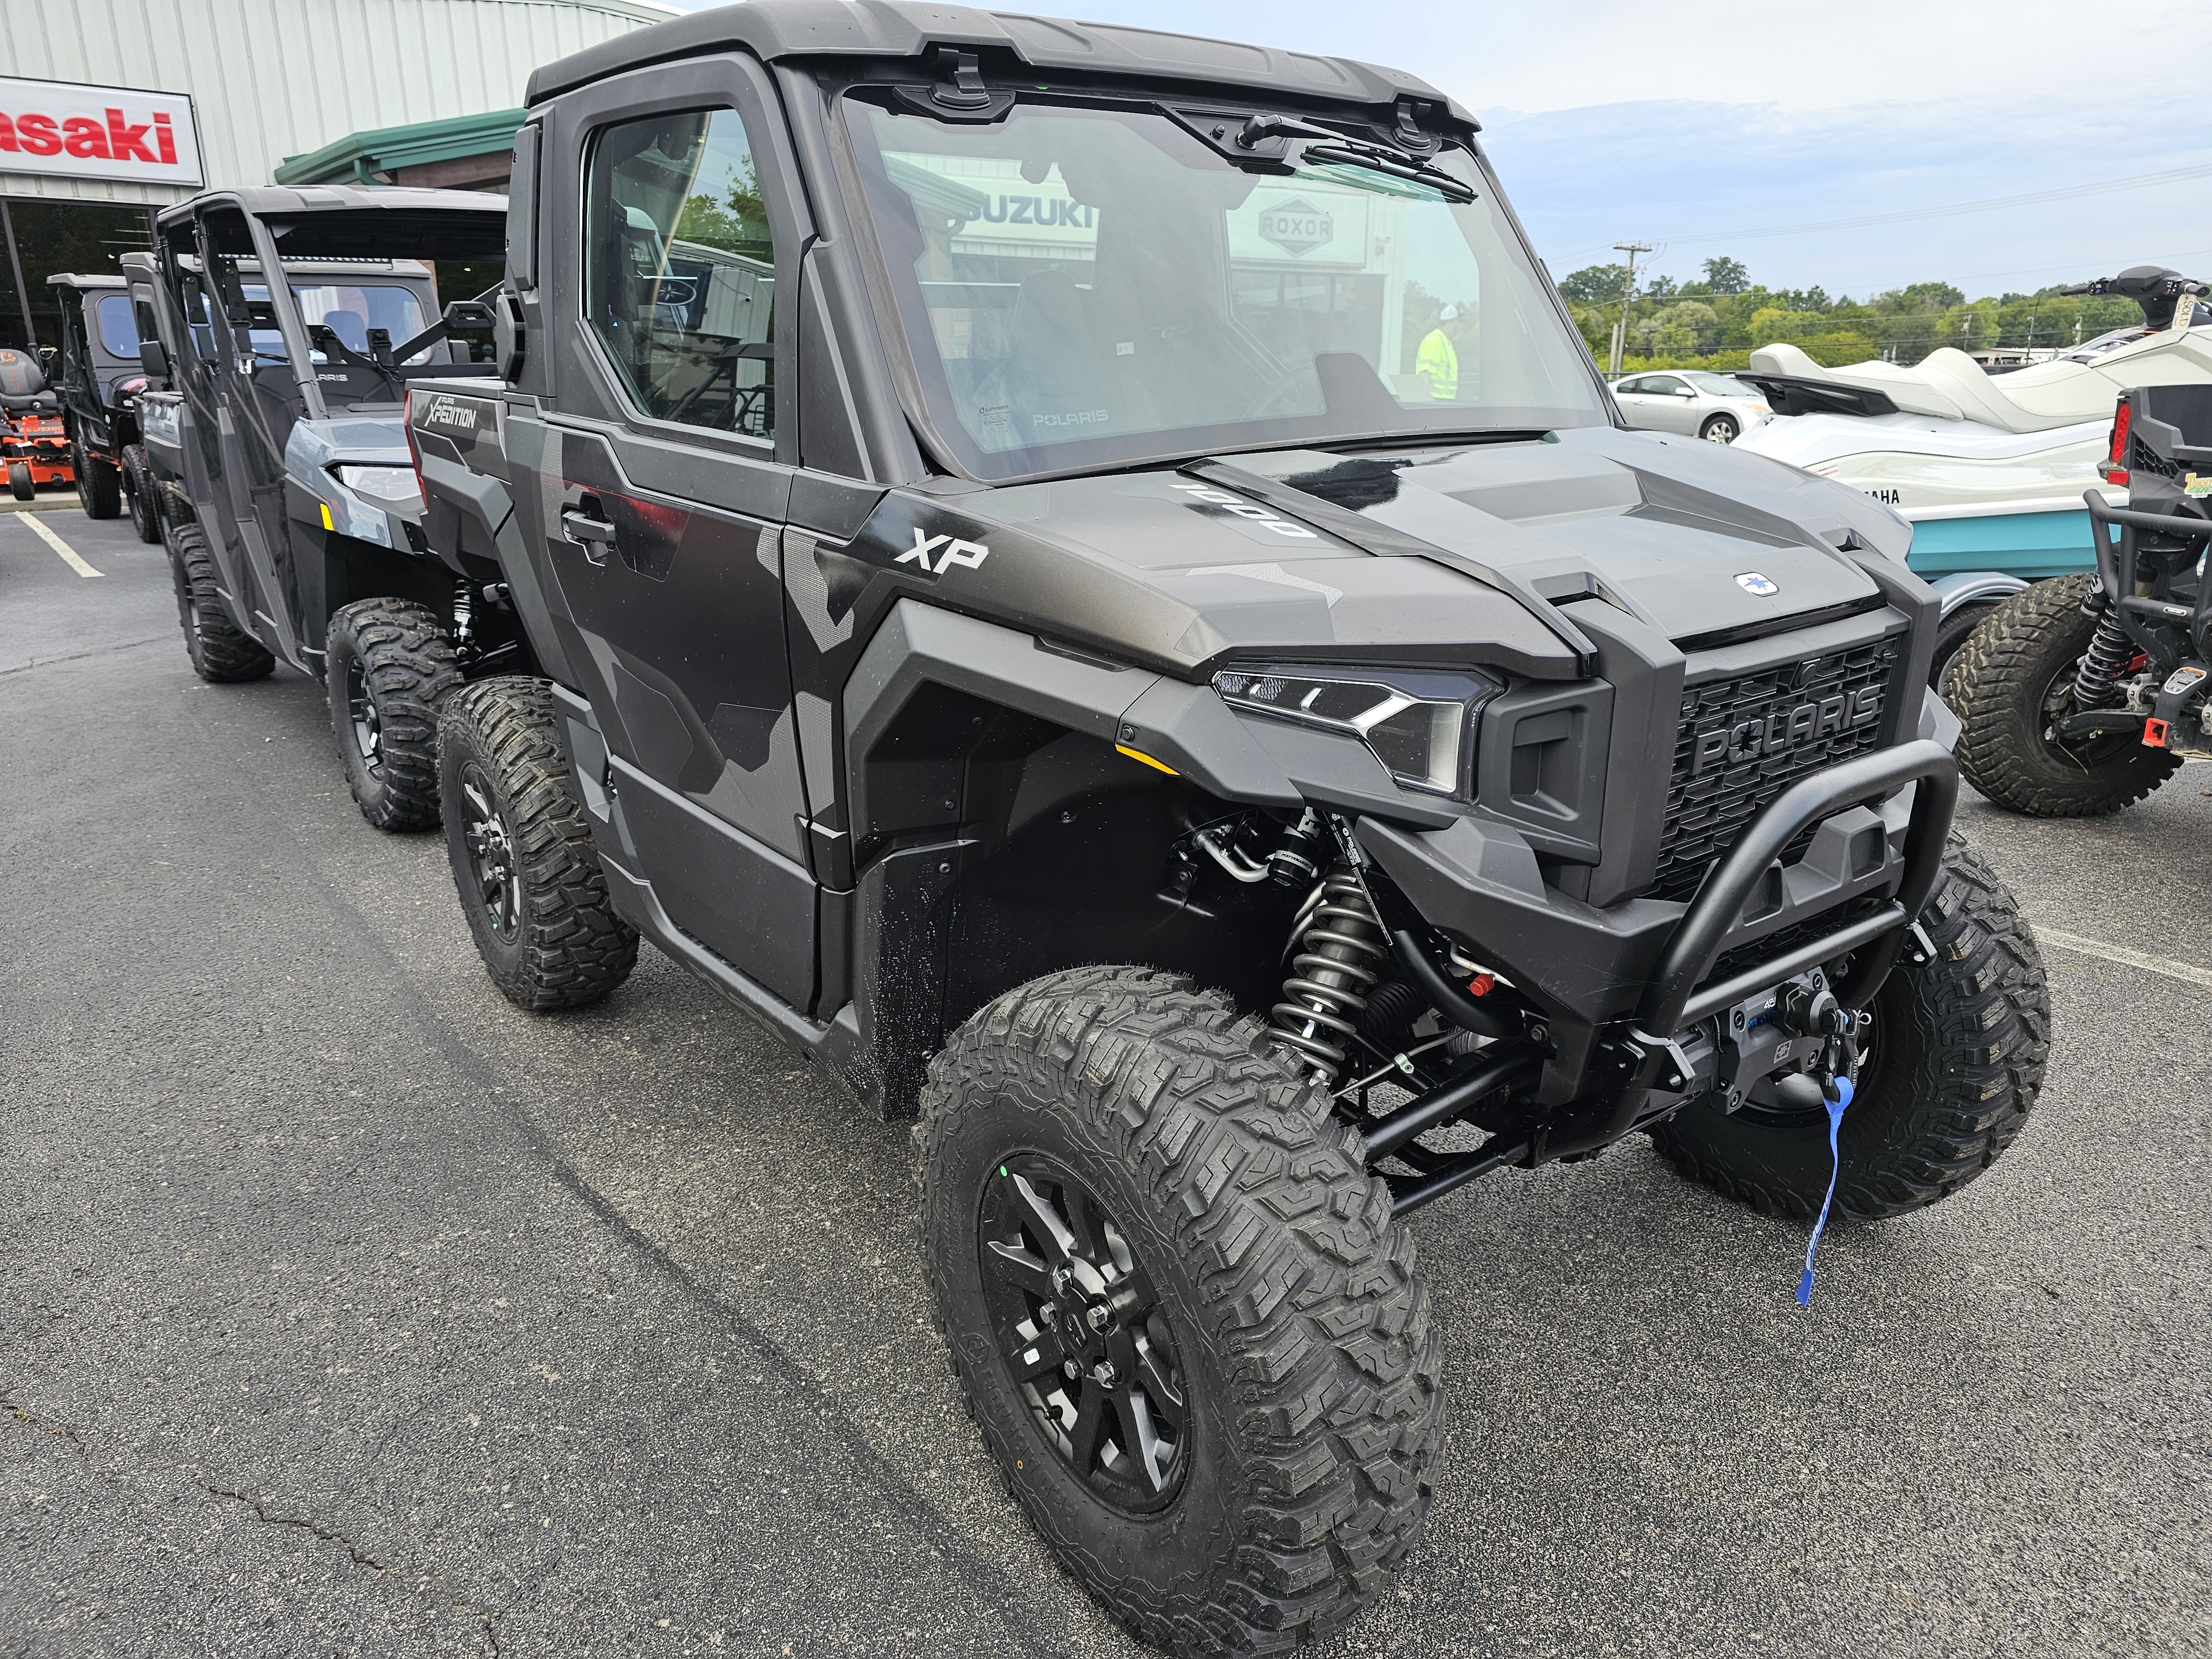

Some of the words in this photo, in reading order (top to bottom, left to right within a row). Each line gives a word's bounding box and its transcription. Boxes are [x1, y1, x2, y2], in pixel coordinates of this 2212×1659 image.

[1262, 216, 1330, 237] ROXOR
[2180, 301, 2194, 326] SOLD
[424, 396, 477, 429] XPEDITION
[1032, 409, 1109, 426] POLARIS
[1168, 484, 1318, 538] 1000
[1864, 489, 1900, 504] AHA
[893, 526, 989, 575] XP
[1692, 684, 1881, 776] POLARIS
